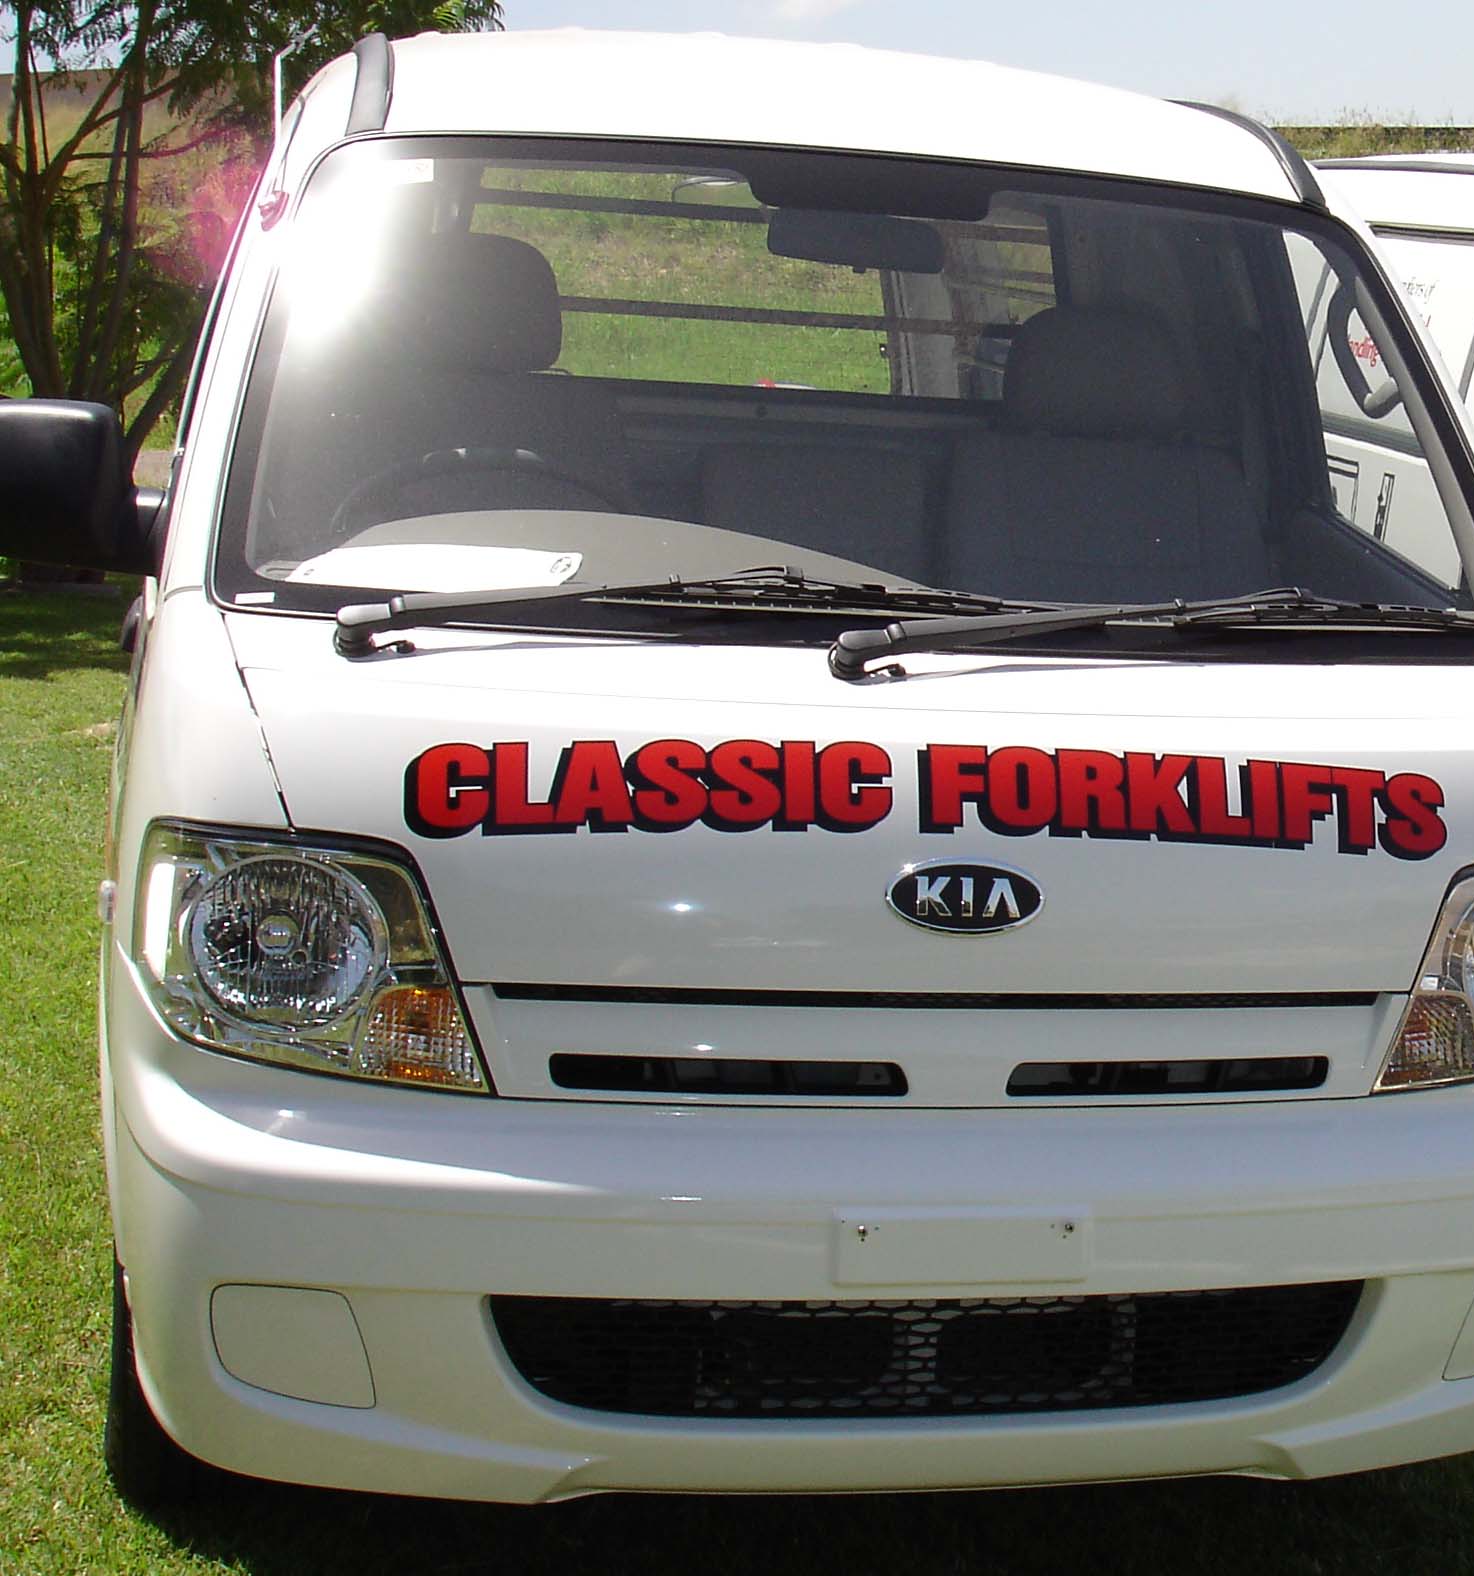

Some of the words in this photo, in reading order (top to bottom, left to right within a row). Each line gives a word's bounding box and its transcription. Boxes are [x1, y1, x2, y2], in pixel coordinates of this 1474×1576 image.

[405, 739, 894, 837] CLASSIC
[916, 743, 1448, 860] FORKLIFTS
[915, 875, 1021, 918] KIA
